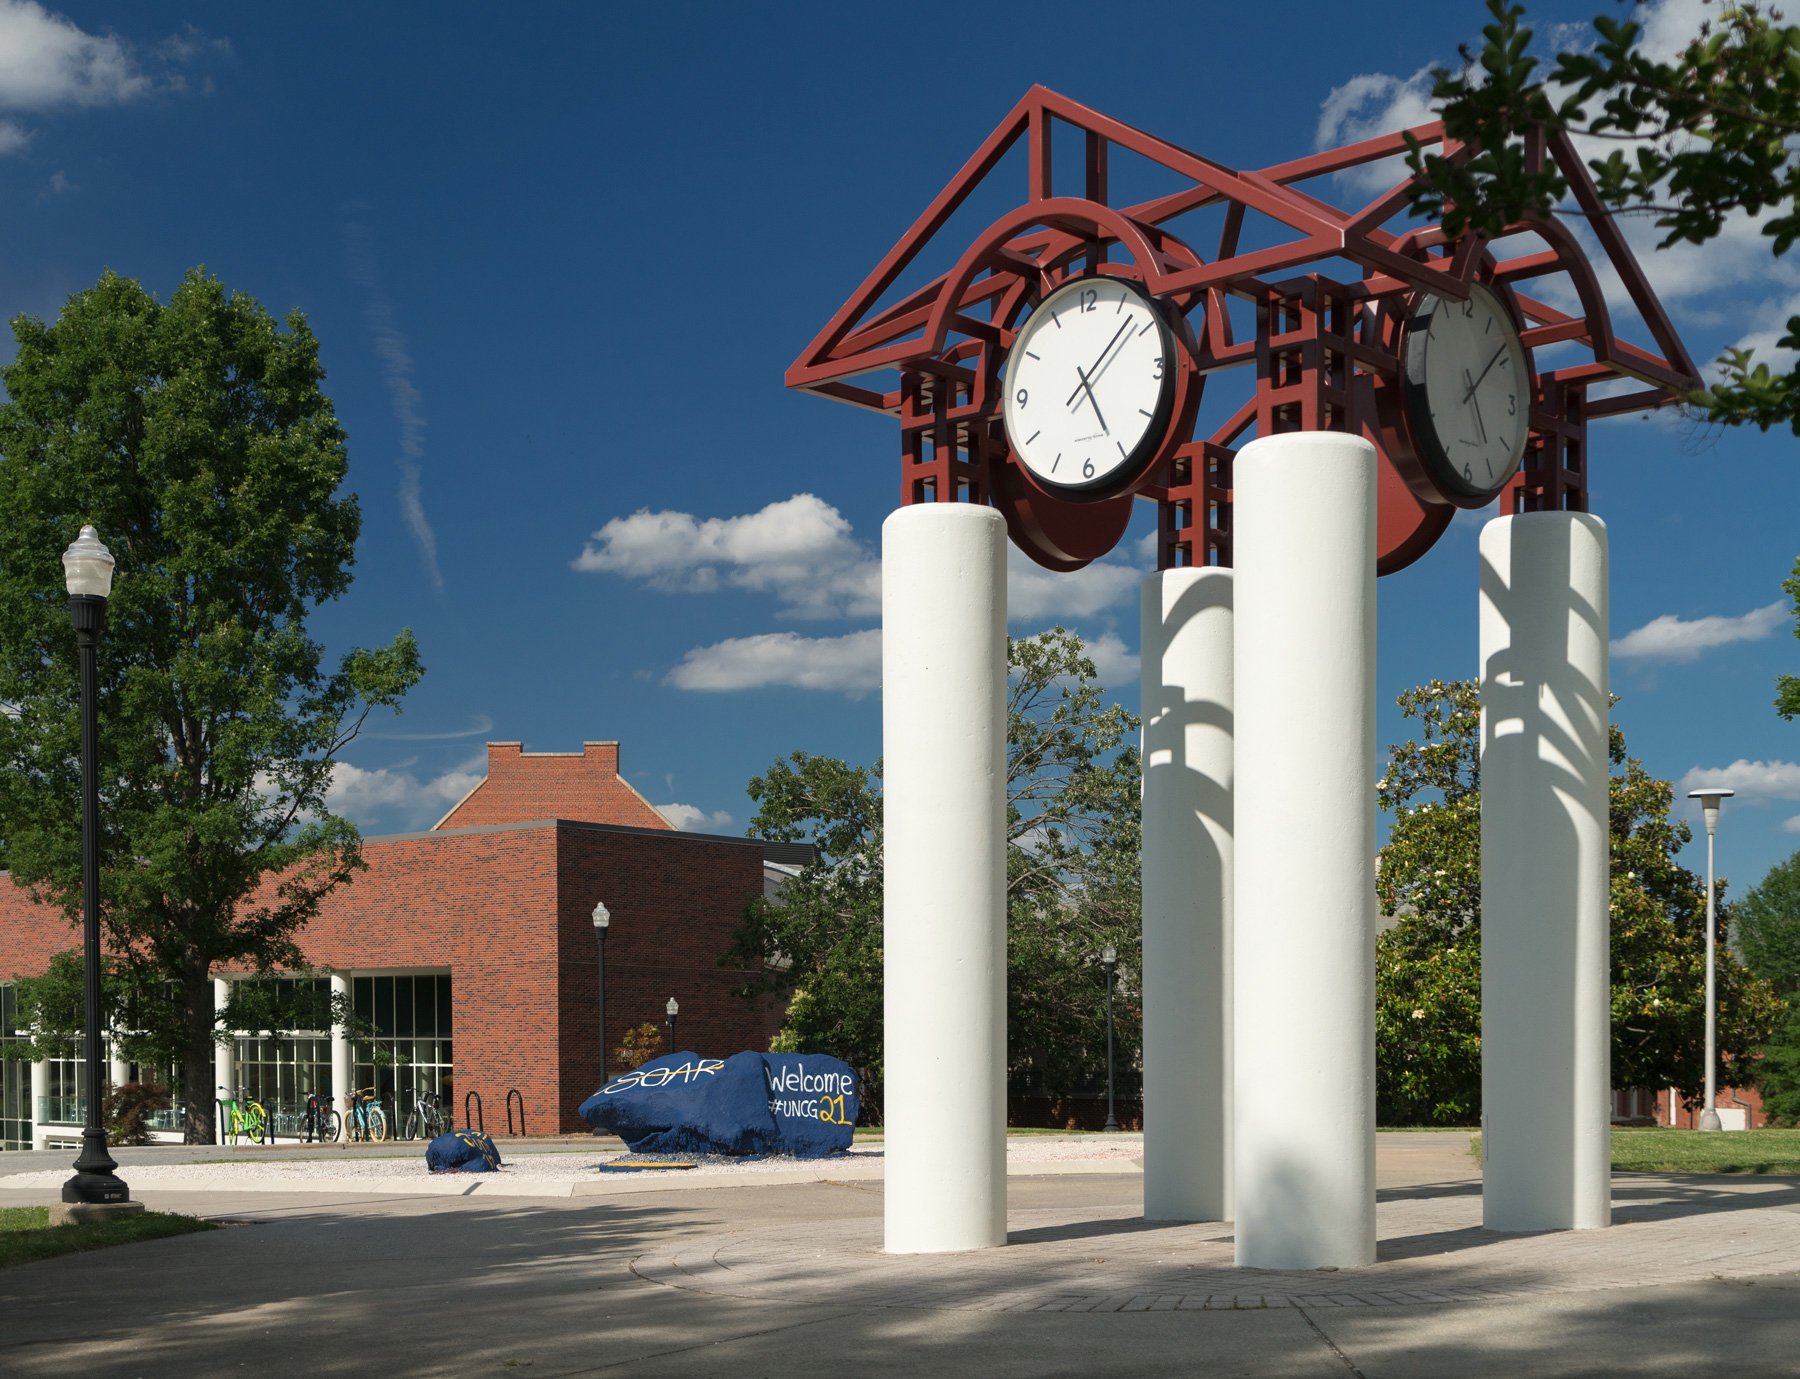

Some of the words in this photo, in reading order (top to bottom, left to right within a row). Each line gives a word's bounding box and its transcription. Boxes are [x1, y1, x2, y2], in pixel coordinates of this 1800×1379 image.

[1080, 289, 1098, 314] 12
[1152, 356, 1164, 380] 3
[1016, 388, 1028, 410] 9
[1507, 394, 1516, 416] 3
[1082, 457, 1095, 479] 6
[1463, 461, 1473, 483] 6
[604, 1059, 725, 1094] SOAR
[765, 1063, 853, 1096] Welcome
